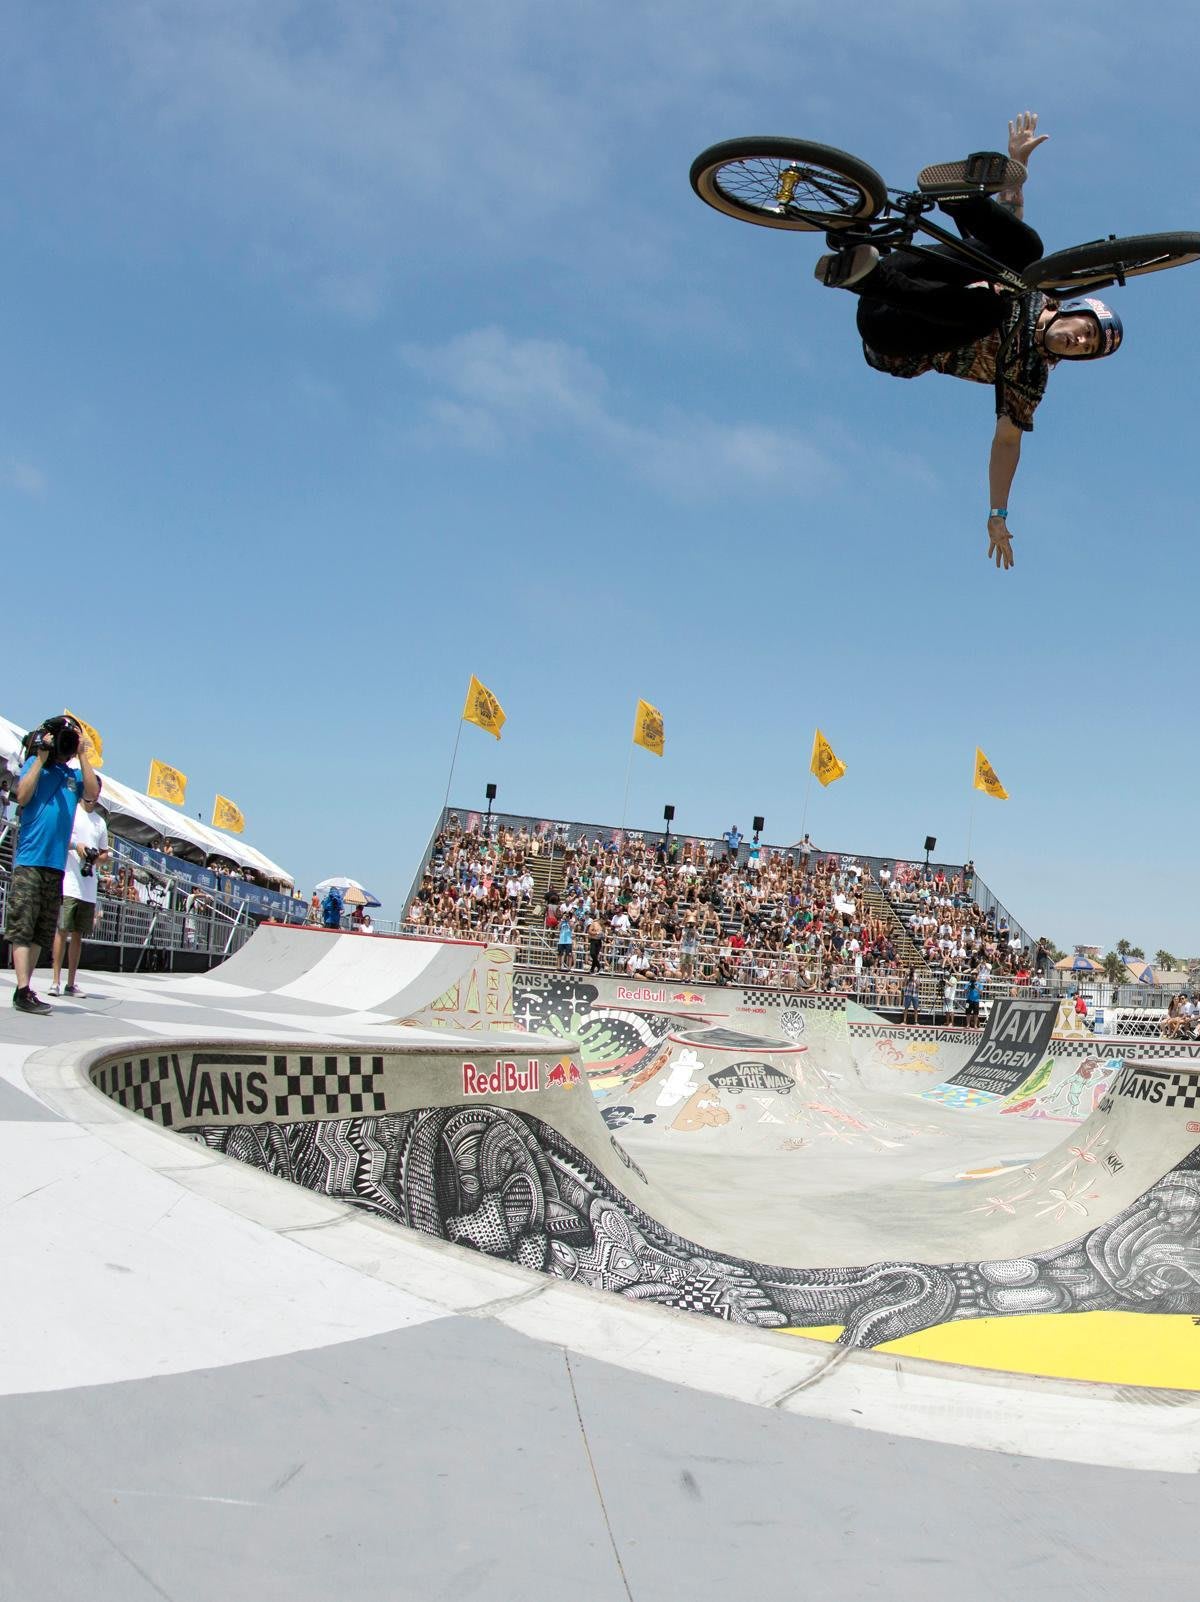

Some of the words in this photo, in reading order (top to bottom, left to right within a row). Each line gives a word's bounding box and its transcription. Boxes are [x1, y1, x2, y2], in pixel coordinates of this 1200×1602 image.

[513, 971, 543, 987] ANS
[617, 986, 641, 1000] Red
[642, 989, 667, 1002] Bull
[782, 994, 815, 1009] VANS
[989, 1000, 1053, 1043] VAN
[871, 1026, 906, 1040] VANS
[935, 1030, 961, 1044] VANS
[974, 1041, 1037, 1068] DOREN
[1095, 1044, 1137, 1058] VANS
[734, 1064, 766, 1075] VANS
[964, 1065, 1023, 1082] INVITATIONAL
[172, 1053, 268, 1118] VANS
[462, 1060, 502, 1096] Red
[503, 1060, 540, 1093] Bull
[741, 1076, 765, 1088] THE
[1119, 1066, 1171, 1103] VANS
[1106, 1153, 1124, 1173] KIKI
